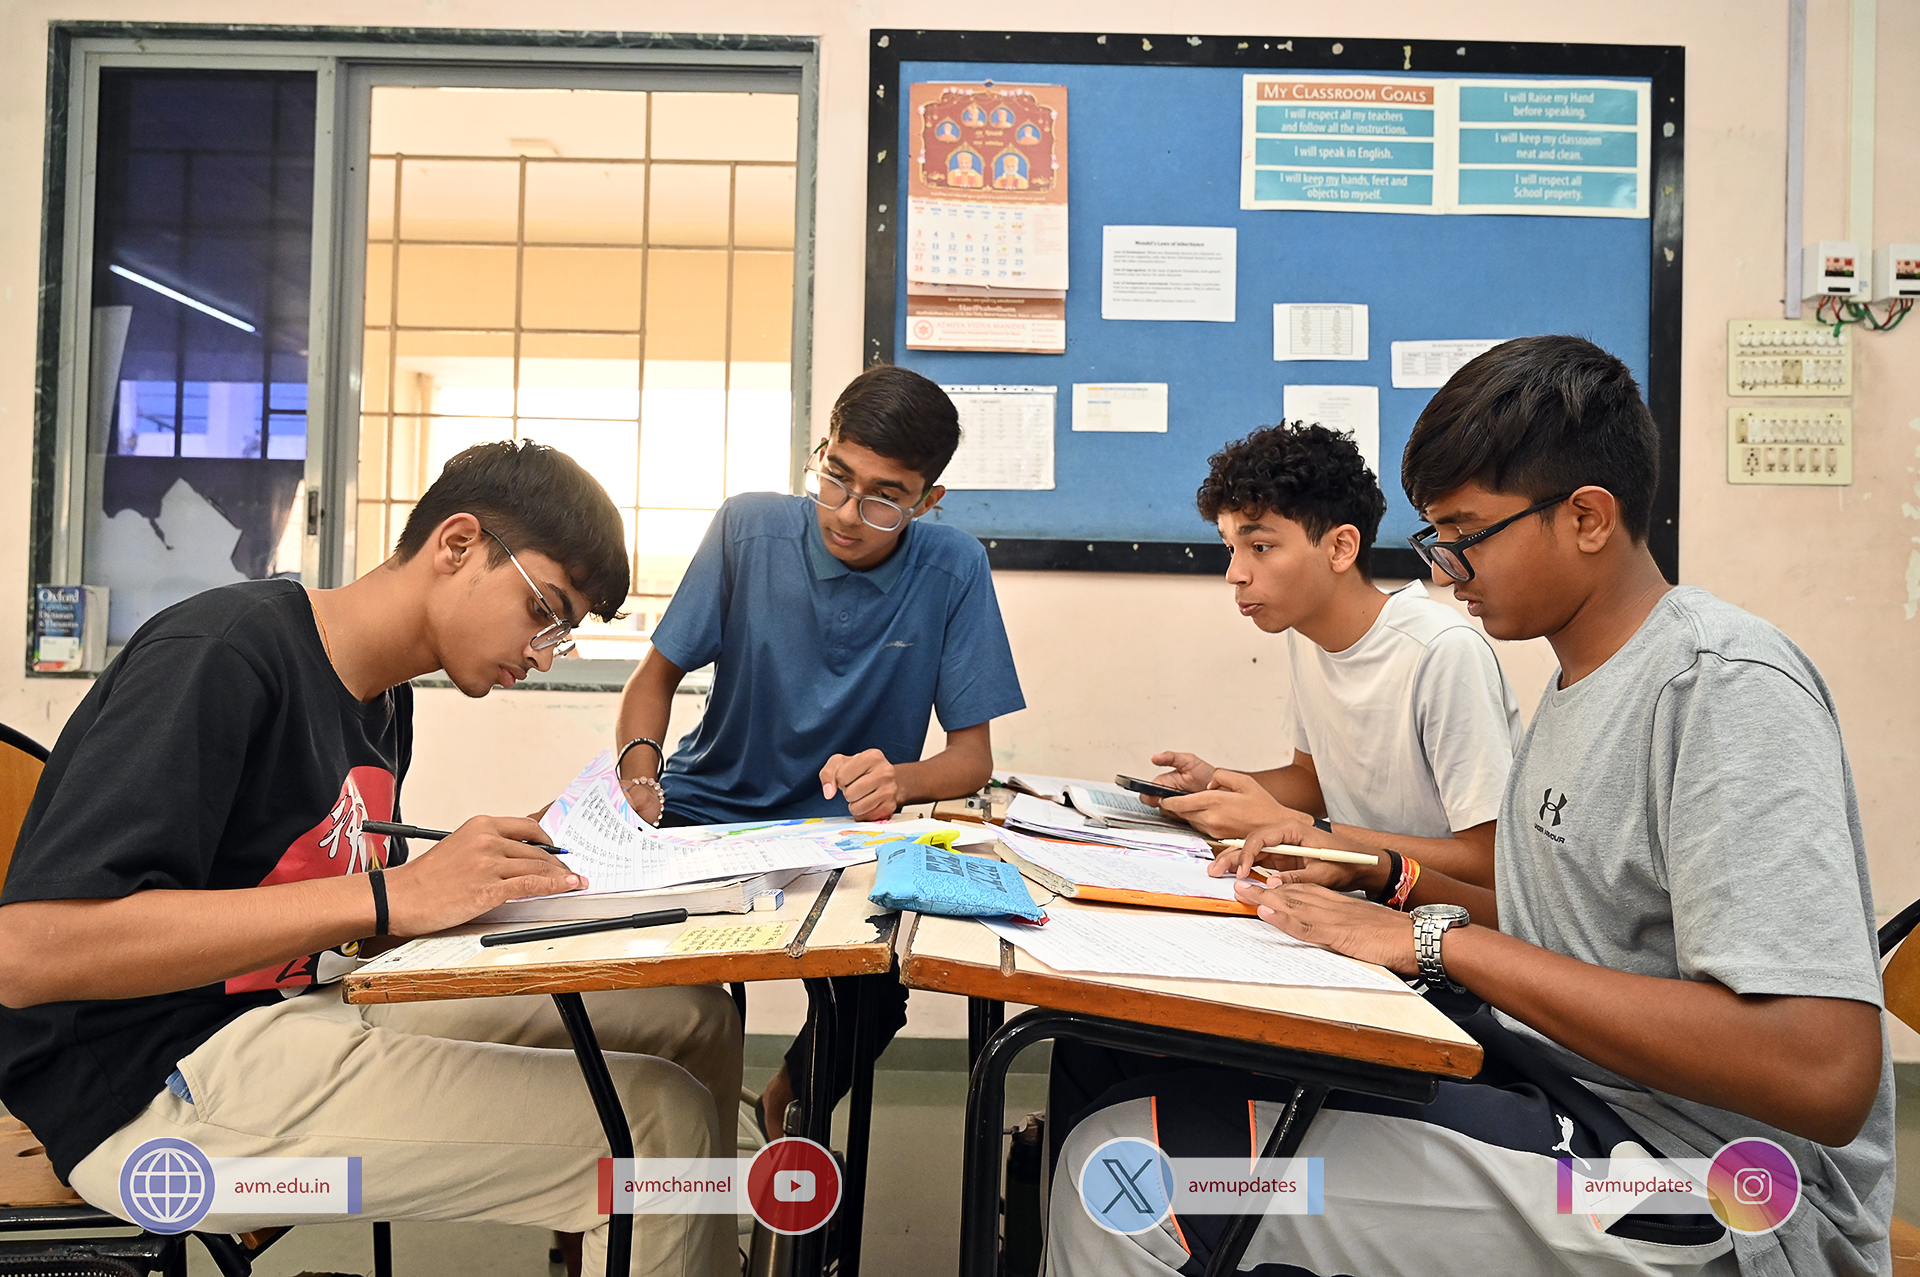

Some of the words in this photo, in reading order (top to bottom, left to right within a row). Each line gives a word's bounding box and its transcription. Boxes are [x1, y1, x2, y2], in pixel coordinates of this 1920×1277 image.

[1504, 92, 1508, 102] I
[1509, 92, 1527, 102] will
[1528, 92, 1552, 103] Raise
[1554, 95, 1569, 105] my
[1570, 92, 1594, 103] Hand
[1285, 109, 1288, 118] I
[1290, 109, 1306, 119] will
[1308, 111, 1338, 121] respect
[1340, 110, 1350, 119] all
[1353, 112, 1366, 122] my
[1368, 111, 1403, 122] teachers
[1513, 105, 1543, 116] before
[1545, 107, 1587, 119] speaking.
[1281, 122, 1298, 132] and
[1299, 122, 1326, 133] follow
[1328, 123, 1338, 133] all
[1340, 124, 1355, 133] the
[1356, 124, 1408, 135] instructions.
[1495, 133, 1498, 143] I
[1500, 133, 1518, 143] will
[1519, 133, 1541, 145] keep
[1543, 135, 1557, 146] my
[1558, 133, 1602, 146] classroom
[1295, 146, 1298, 156] I
[1300, 146, 1317, 157] will
[1319, 147, 1345, 160] speak
[1347, 147, 1356, 157] in
[1358, 148, 1393, 161] English.
[1516, 149, 1537, 158] neat
[1538, 149, 1555, 159] and
[1557, 150, 1583, 161] clean.
[1280, 173, 1283, 182] I
[1285, 173, 1301, 183] will
[1303, 173, 1324, 185] keep
[1326, 176, 1339, 186] my
[1341, 174, 1370, 186] hands,
[1372, 175, 1389, 185] feet
[1391, 176, 1408, 186] and
[1516, 173, 1519, 184] I
[1520, 174, 1537, 184] will
[1538, 174, 1569, 186] respect
[1571, 175, 1582, 186] all
[1307, 189, 1338, 200] objects
[1340, 190, 1349, 198] to
[1351, 189, 1382, 201] myself.
[1514, 187, 1542, 198] School
[1544, 188, 1583, 201] property.
[38, 589, 79, 603] Oxford
